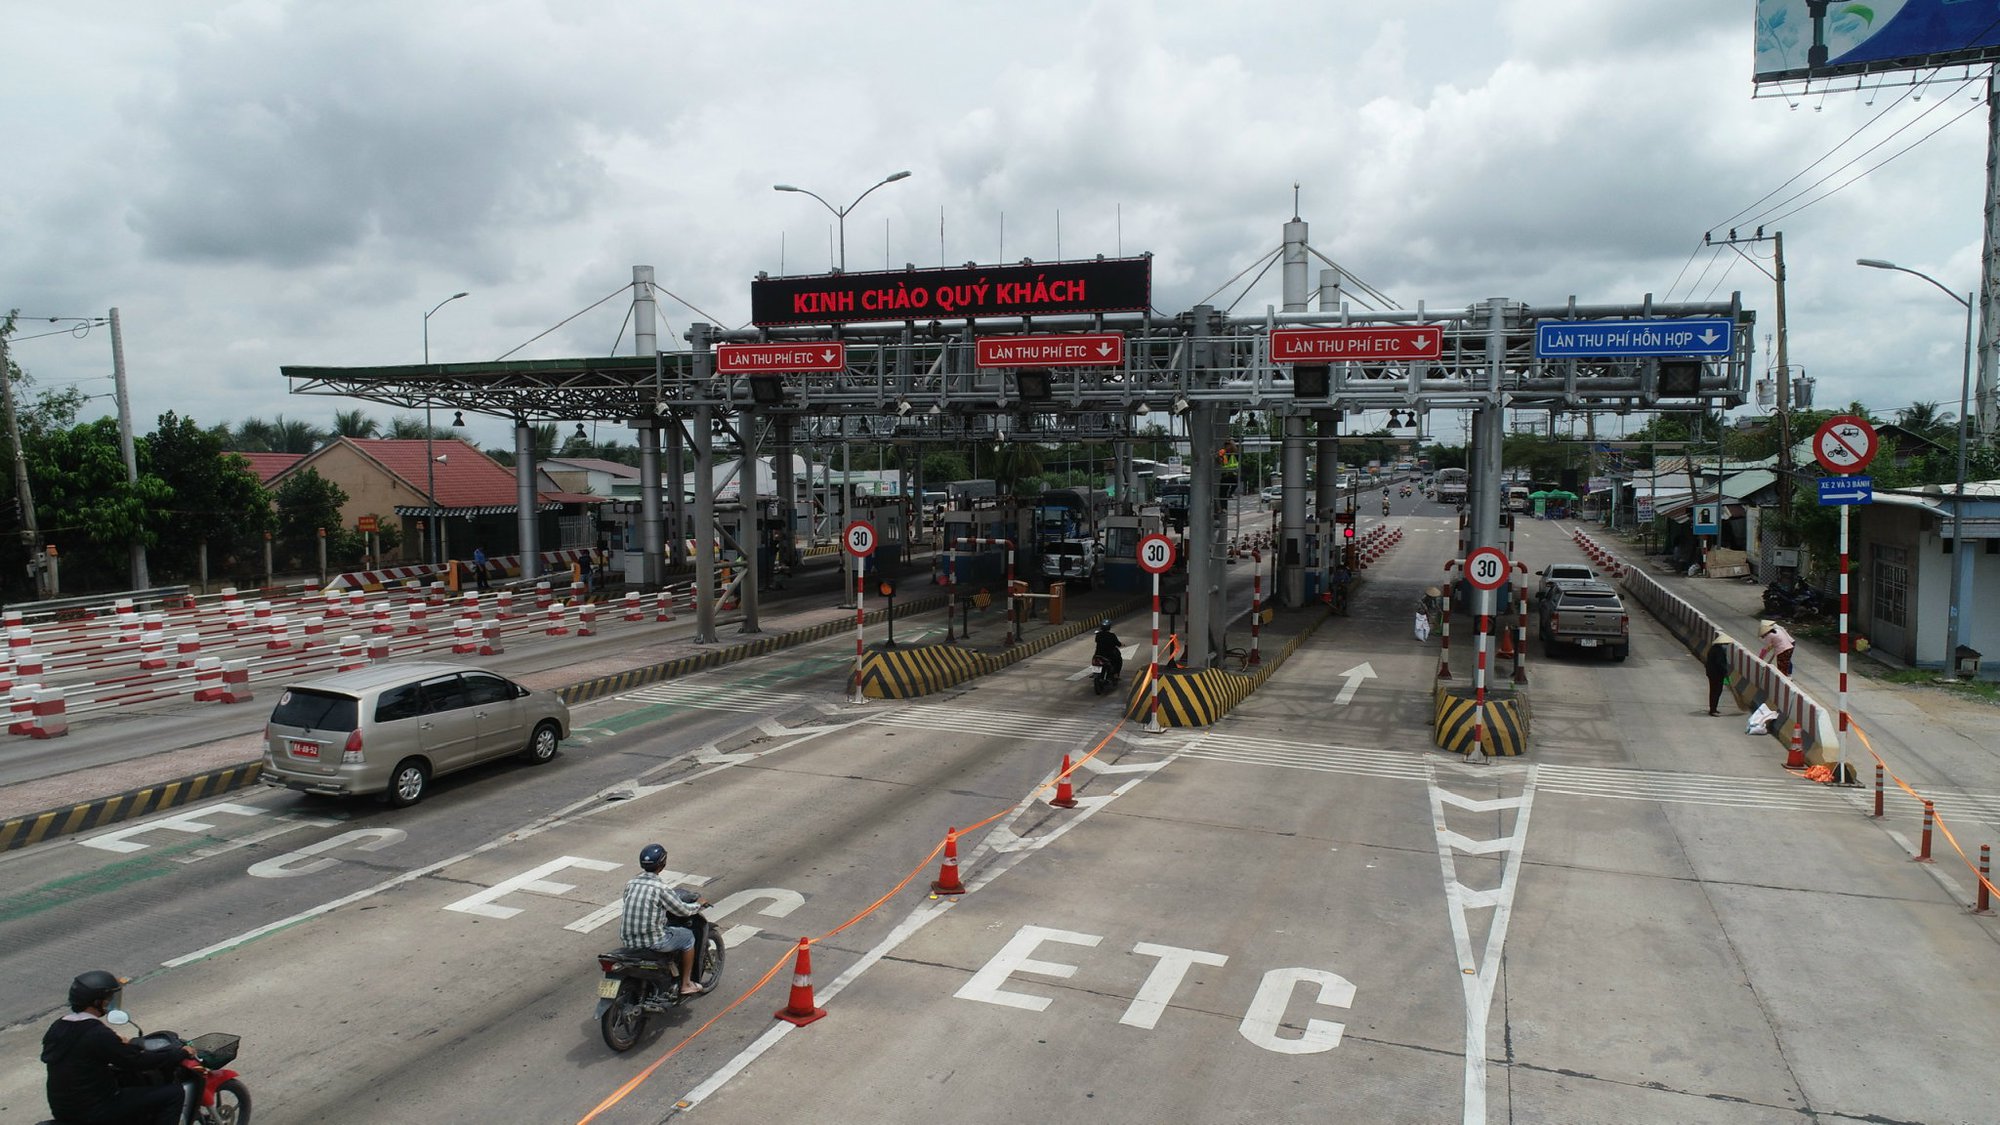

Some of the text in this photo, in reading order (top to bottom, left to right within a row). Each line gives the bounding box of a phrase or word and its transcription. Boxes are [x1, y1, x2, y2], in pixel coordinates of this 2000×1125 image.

[793, 273, 1086, 313] KINH CHÀO QUÝ KHÁCH
[1286, 335, 1400, 353] LÀN THU PHÍ ETC
[1548, 327, 1693, 349] LÀN THU PHÍ HỖN HỢP
[728, 350, 814, 366] LÀN THU PHÍ ETC
[989, 343, 1087, 360] LÀN THU PHÍ ETC
[1820, 481, 1830, 489] XE
[1830, 481, 1836, 489] 2
[1836, 479, 1846, 489] VÀ
[1851, 479, 1870, 488] BÁNH
[853, 531, 868, 546] 30
[1147, 544, 1165, 562] 30
[1477, 559, 1497, 578] 30
[953, 925, 1357, 1055] ETC
